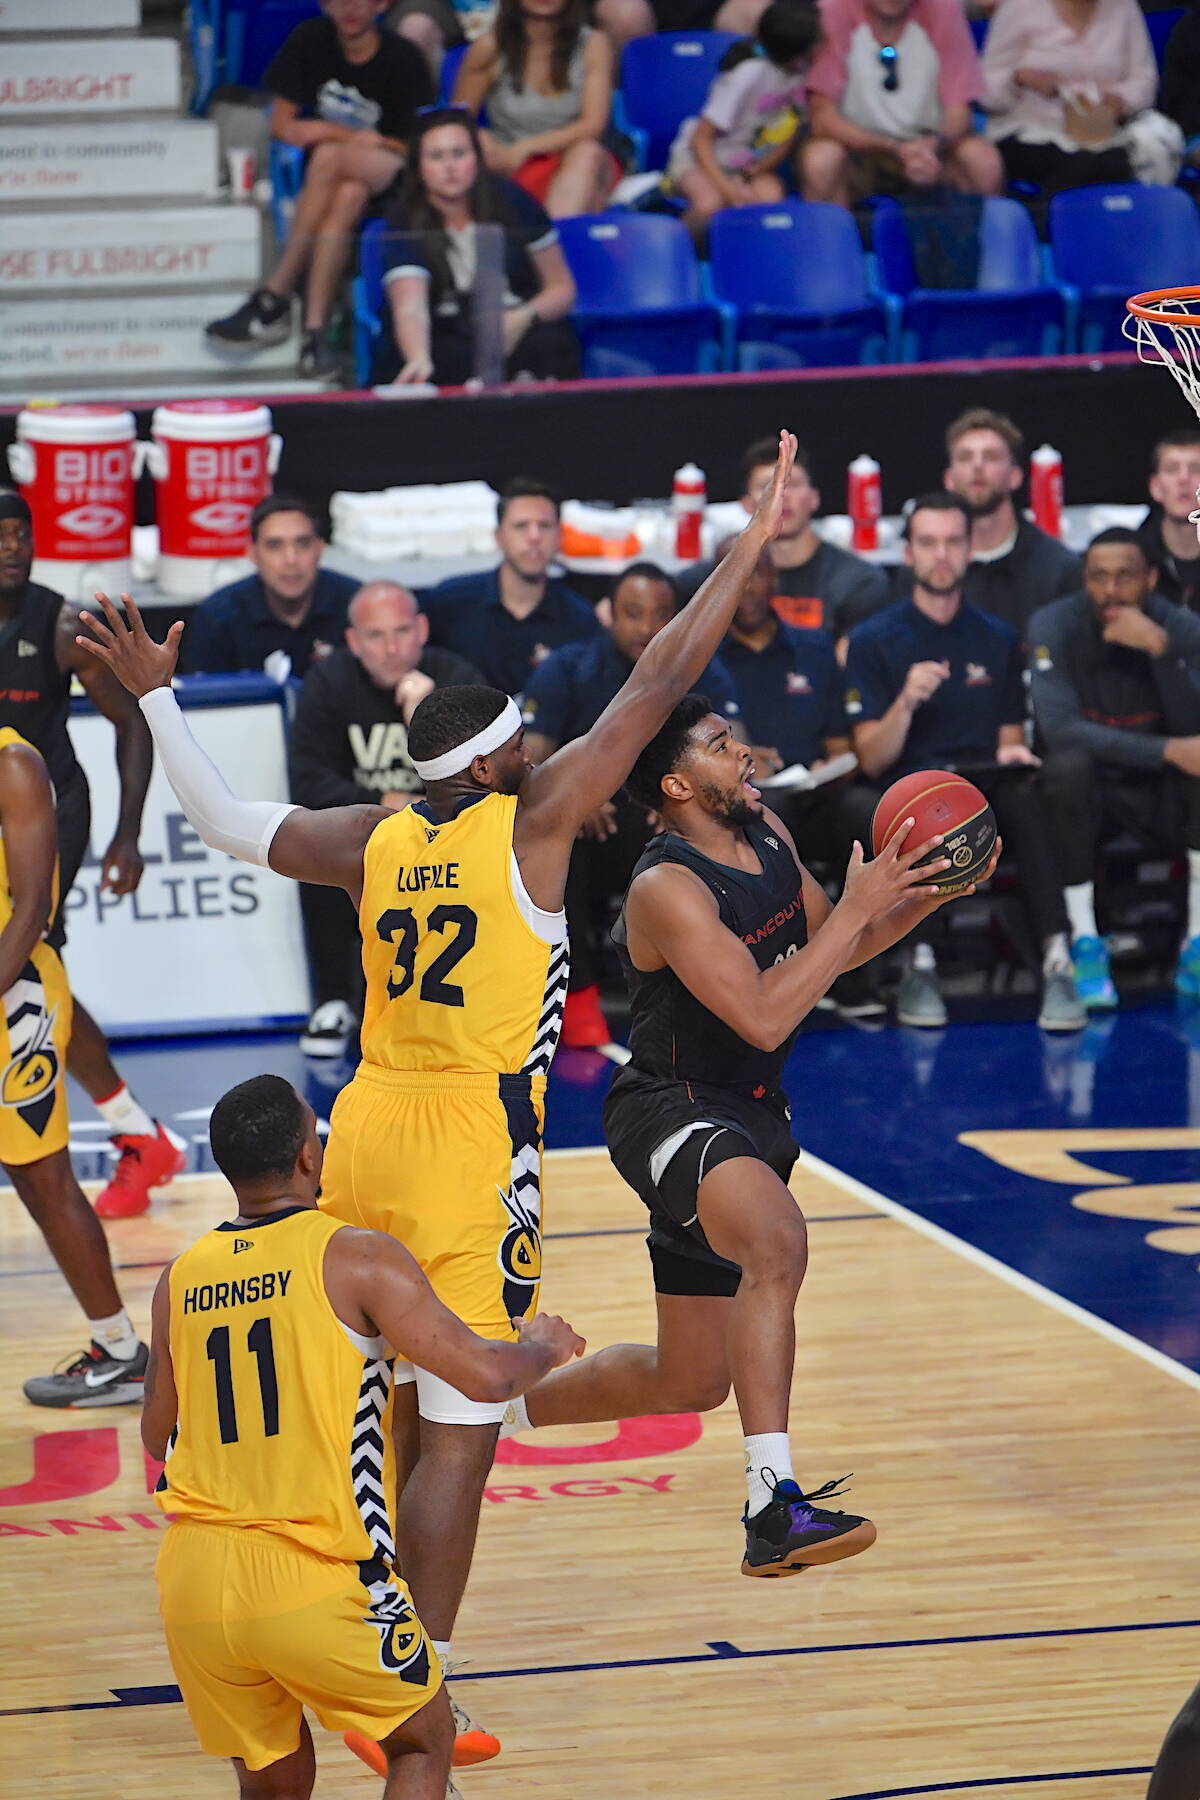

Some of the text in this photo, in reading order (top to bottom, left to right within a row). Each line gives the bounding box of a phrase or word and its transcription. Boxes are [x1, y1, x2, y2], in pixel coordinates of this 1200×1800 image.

[46, 244, 214, 277] FULBRIGHT
[55, 449, 126, 483] BIO
[186, 446, 260, 480] BIO
[397, 862, 460, 893] LUFILE
[376, 904, 479, 1008] 32
[183, 1269, 292, 1315] HORNSBY
[206, 1316, 280, 1445] 11
